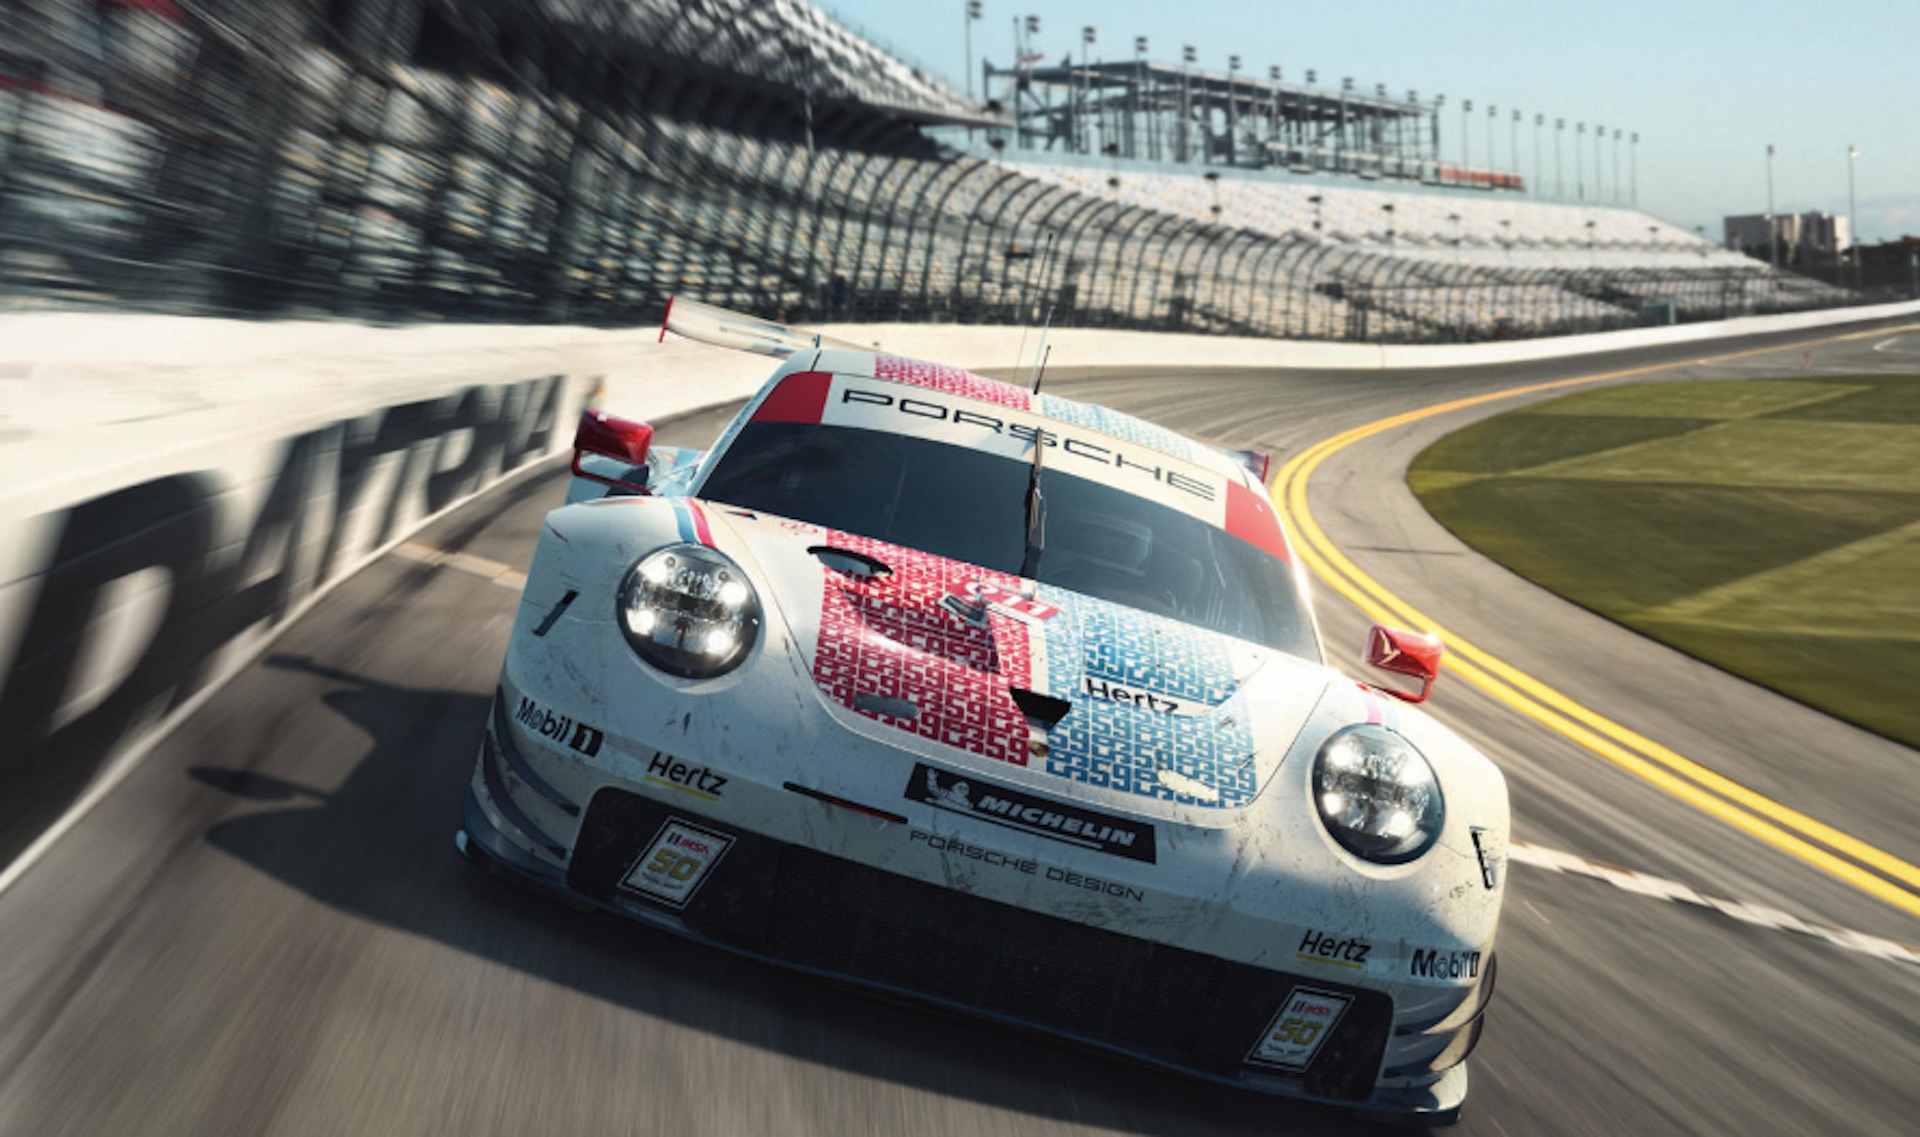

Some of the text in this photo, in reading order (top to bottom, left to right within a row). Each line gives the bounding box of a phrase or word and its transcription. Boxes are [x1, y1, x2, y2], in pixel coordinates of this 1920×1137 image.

[842, 387, 1216, 503] PORSCHE
[515, 696, 572, 743] Mobil
[1084, 677, 1180, 715] Hertz
[648, 750, 728, 797] Hertz
[976, 793, 1137, 848] MICHELIN
[647, 848, 701, 882] 50
[910, 829, 1145, 902] PORSCHE DESIGN
[1299, 928, 1372, 963] Hertz
[1273, 1017, 1324, 1046] 50
